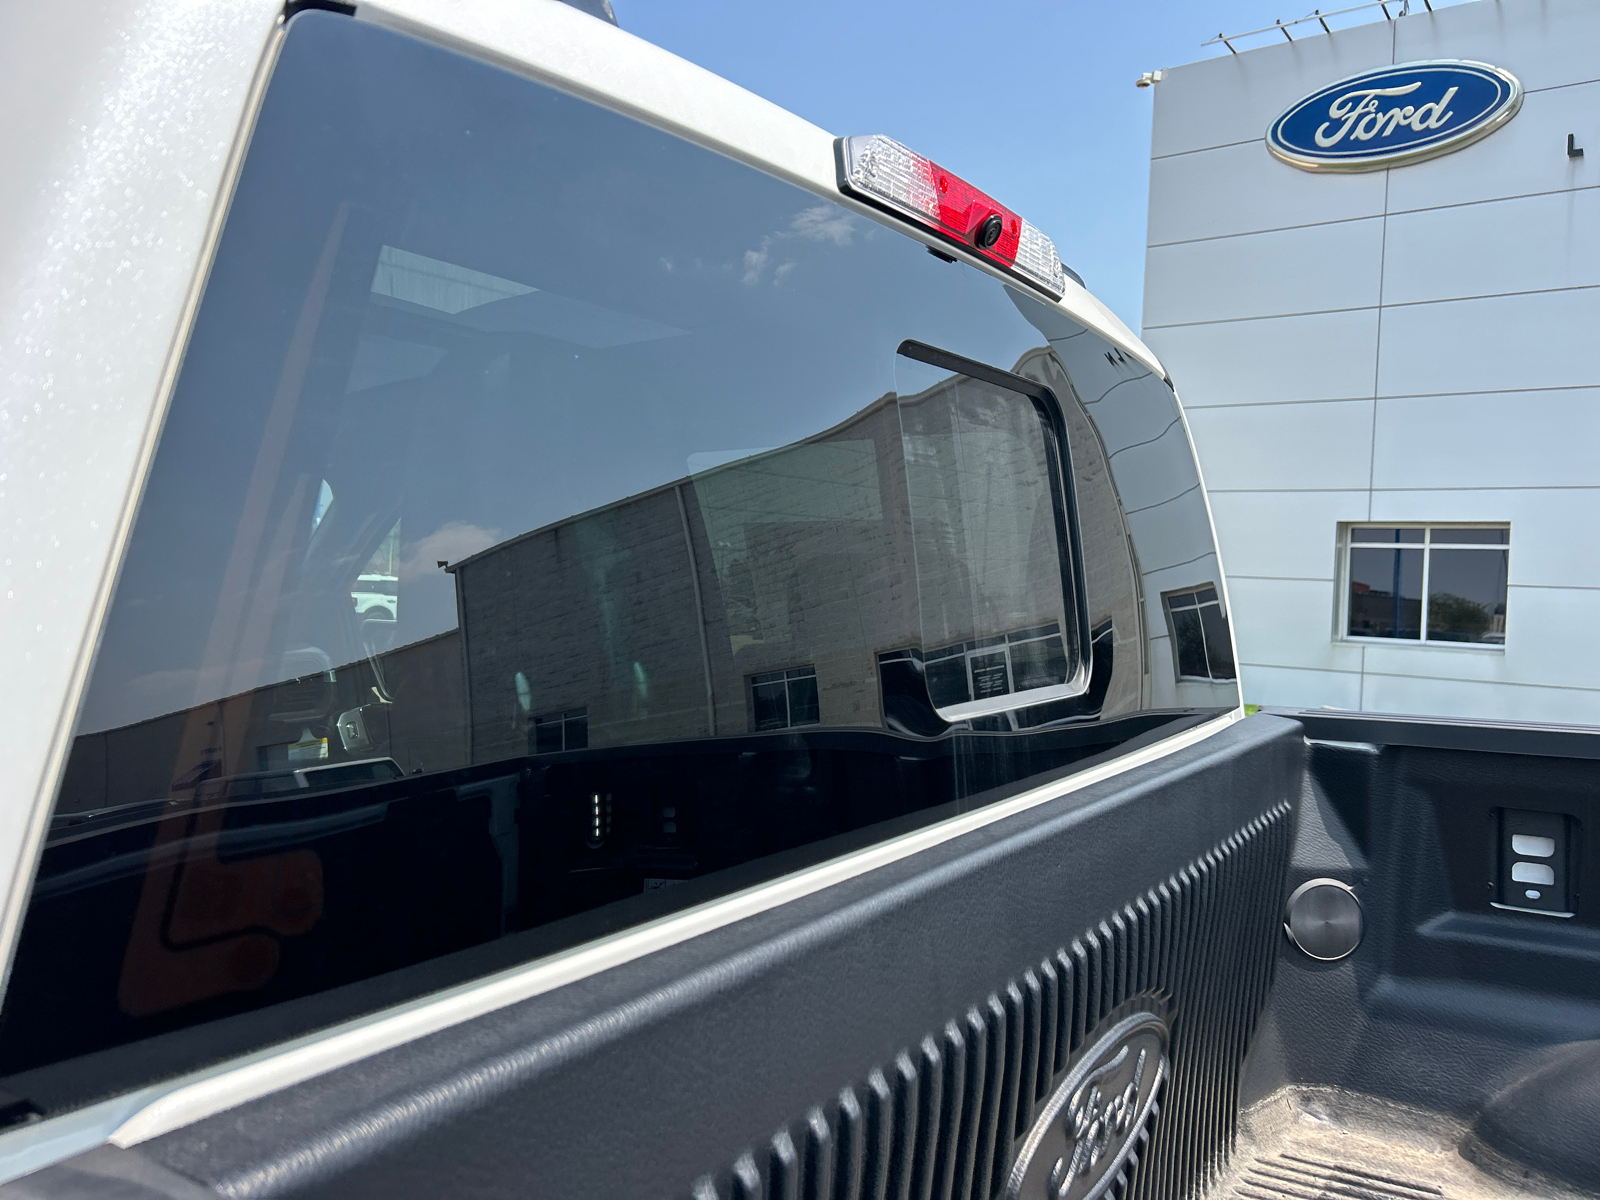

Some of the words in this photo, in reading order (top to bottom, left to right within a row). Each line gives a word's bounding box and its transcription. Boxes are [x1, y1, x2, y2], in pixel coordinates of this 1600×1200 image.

[1314, 81, 1459, 148] Ford
[1567, 133, 1584, 158] L
[1050, 1045, 1147, 1199] Ford
